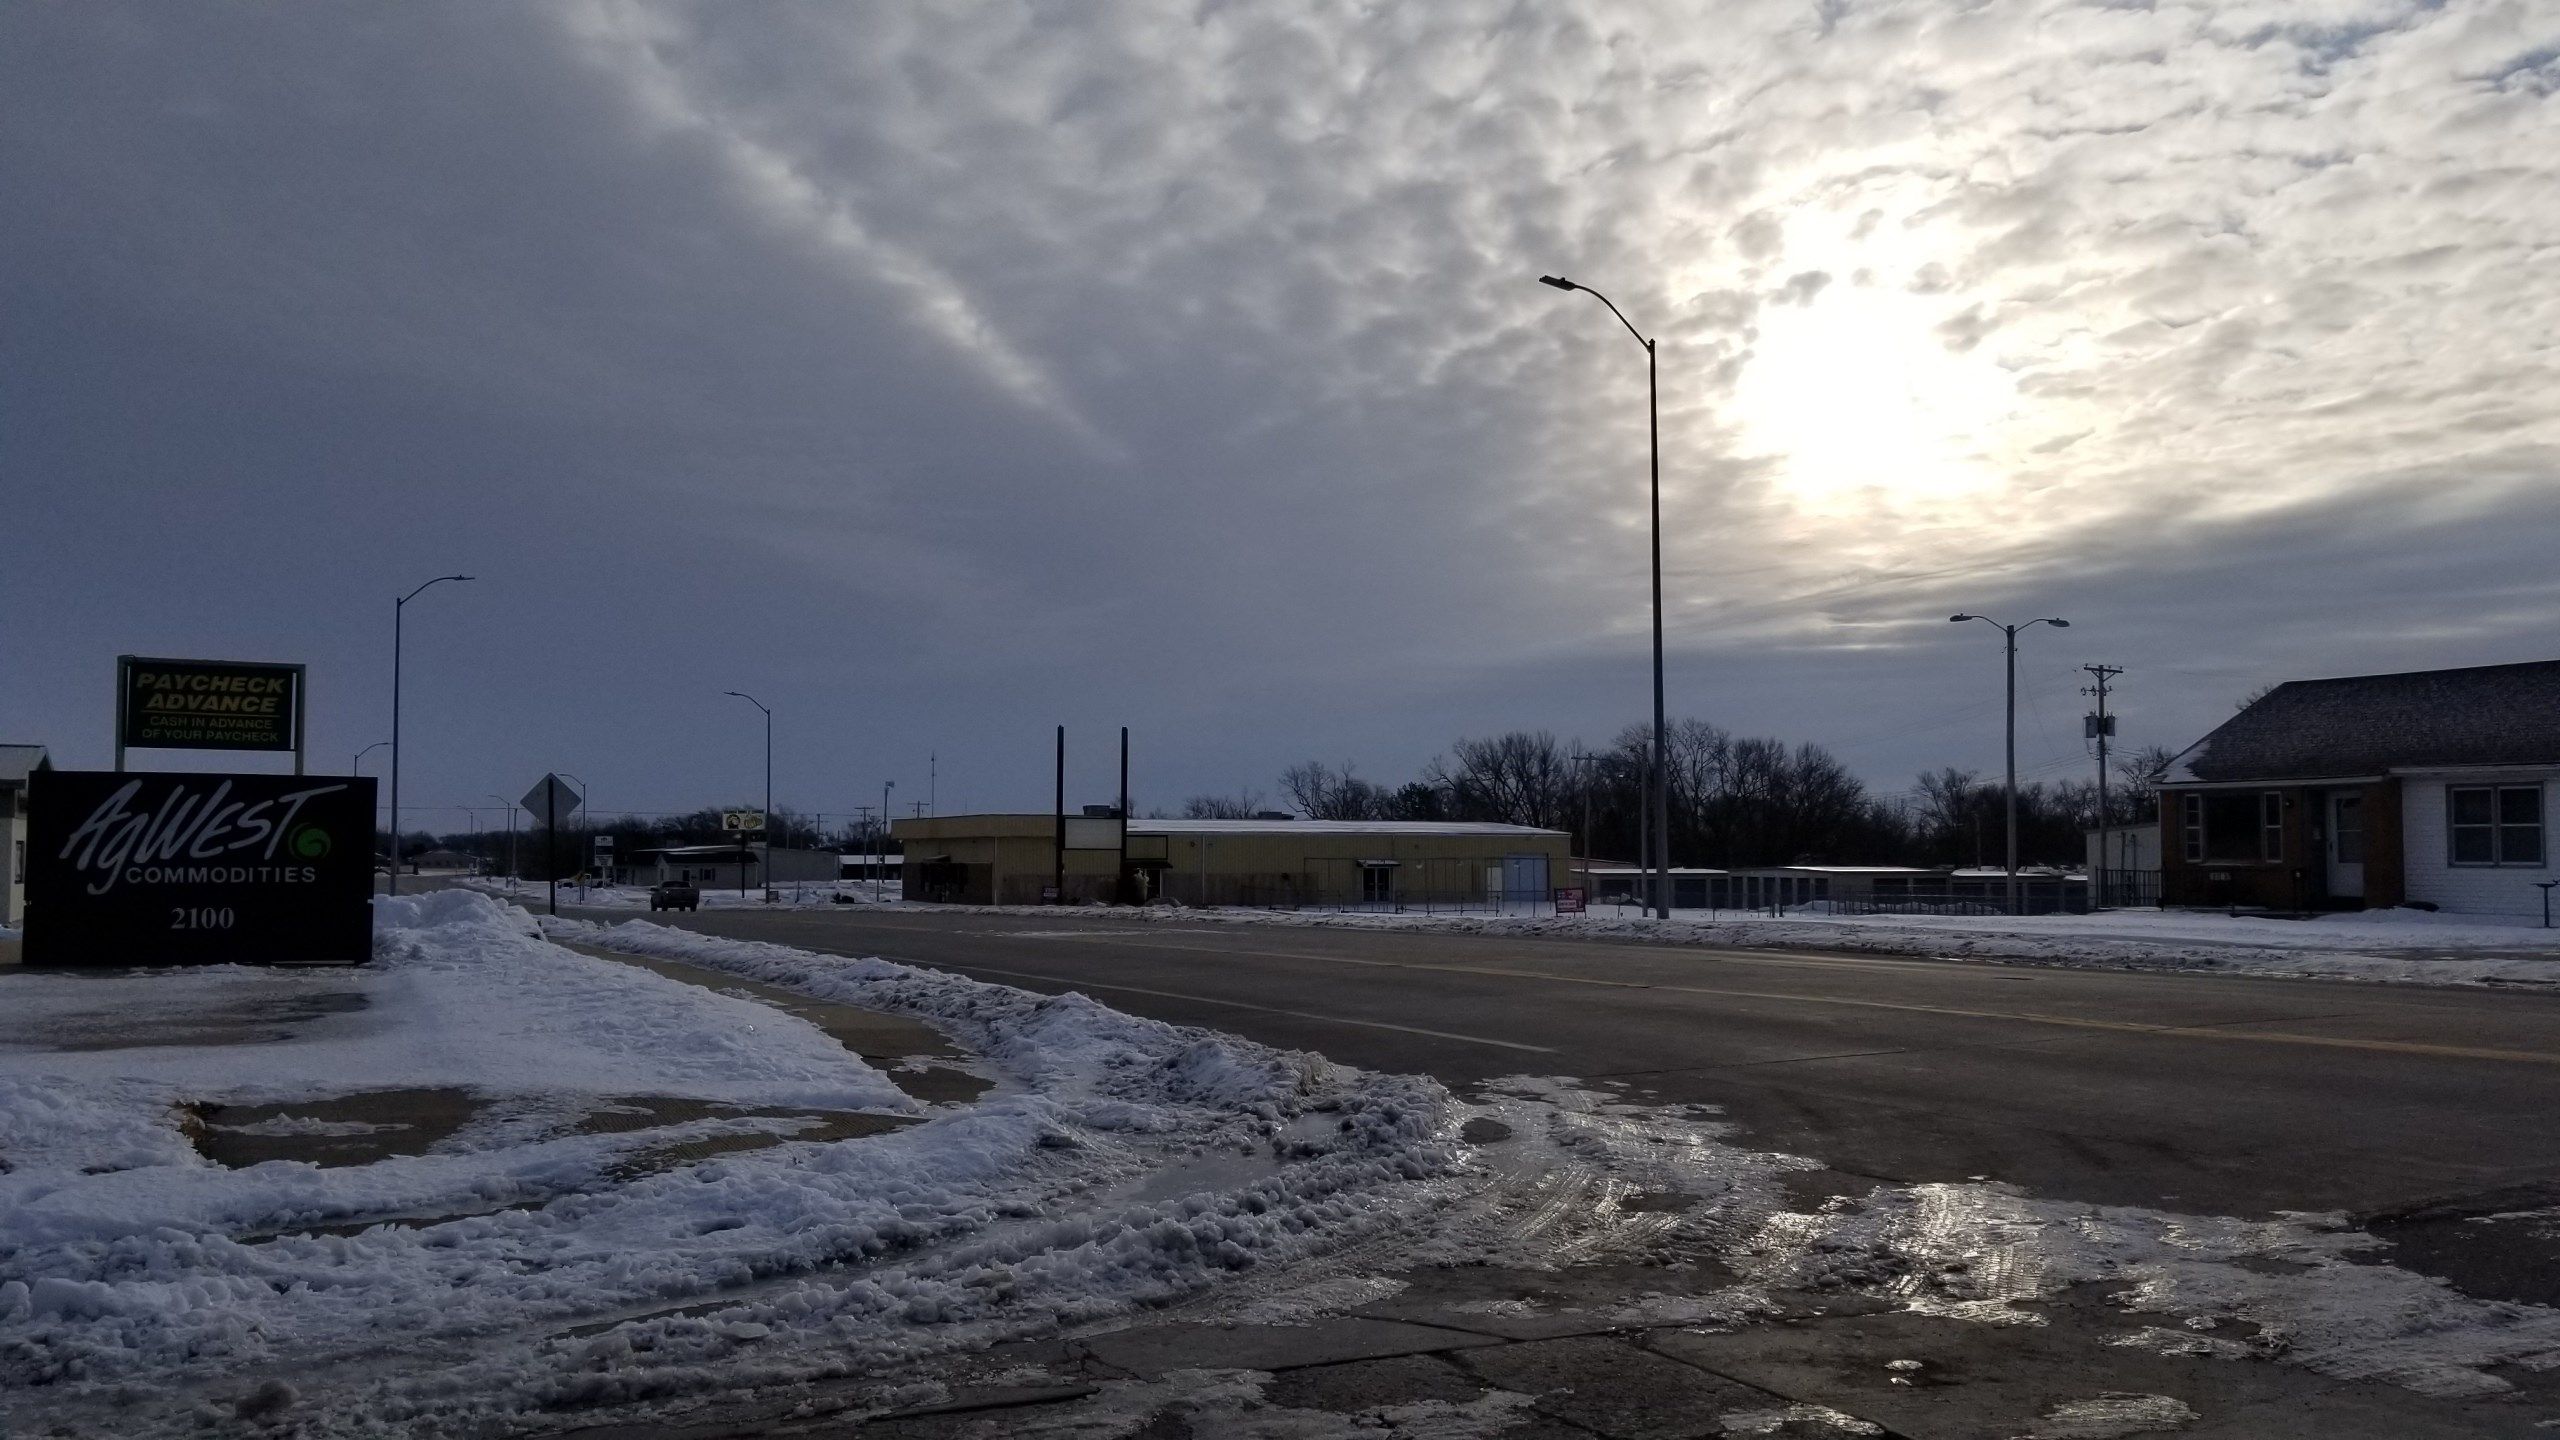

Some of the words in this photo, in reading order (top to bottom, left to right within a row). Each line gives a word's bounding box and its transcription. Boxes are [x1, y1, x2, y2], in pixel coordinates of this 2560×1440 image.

[136, 673, 286, 694] PAYCHECK
[146, 693, 280, 713] ADVANCE
[150, 716, 187, 727] CASH
[192, 716, 206, 727] IN
[208, 718, 273, 730] ADVANCE
[142, 728, 161, 739] OF
[164, 729, 204, 740] YOUR
[205, 730, 279, 743] PAYCHECK
[125, 866, 316, 884] COMMODITIES
[170, 907, 235, 930] 2100
